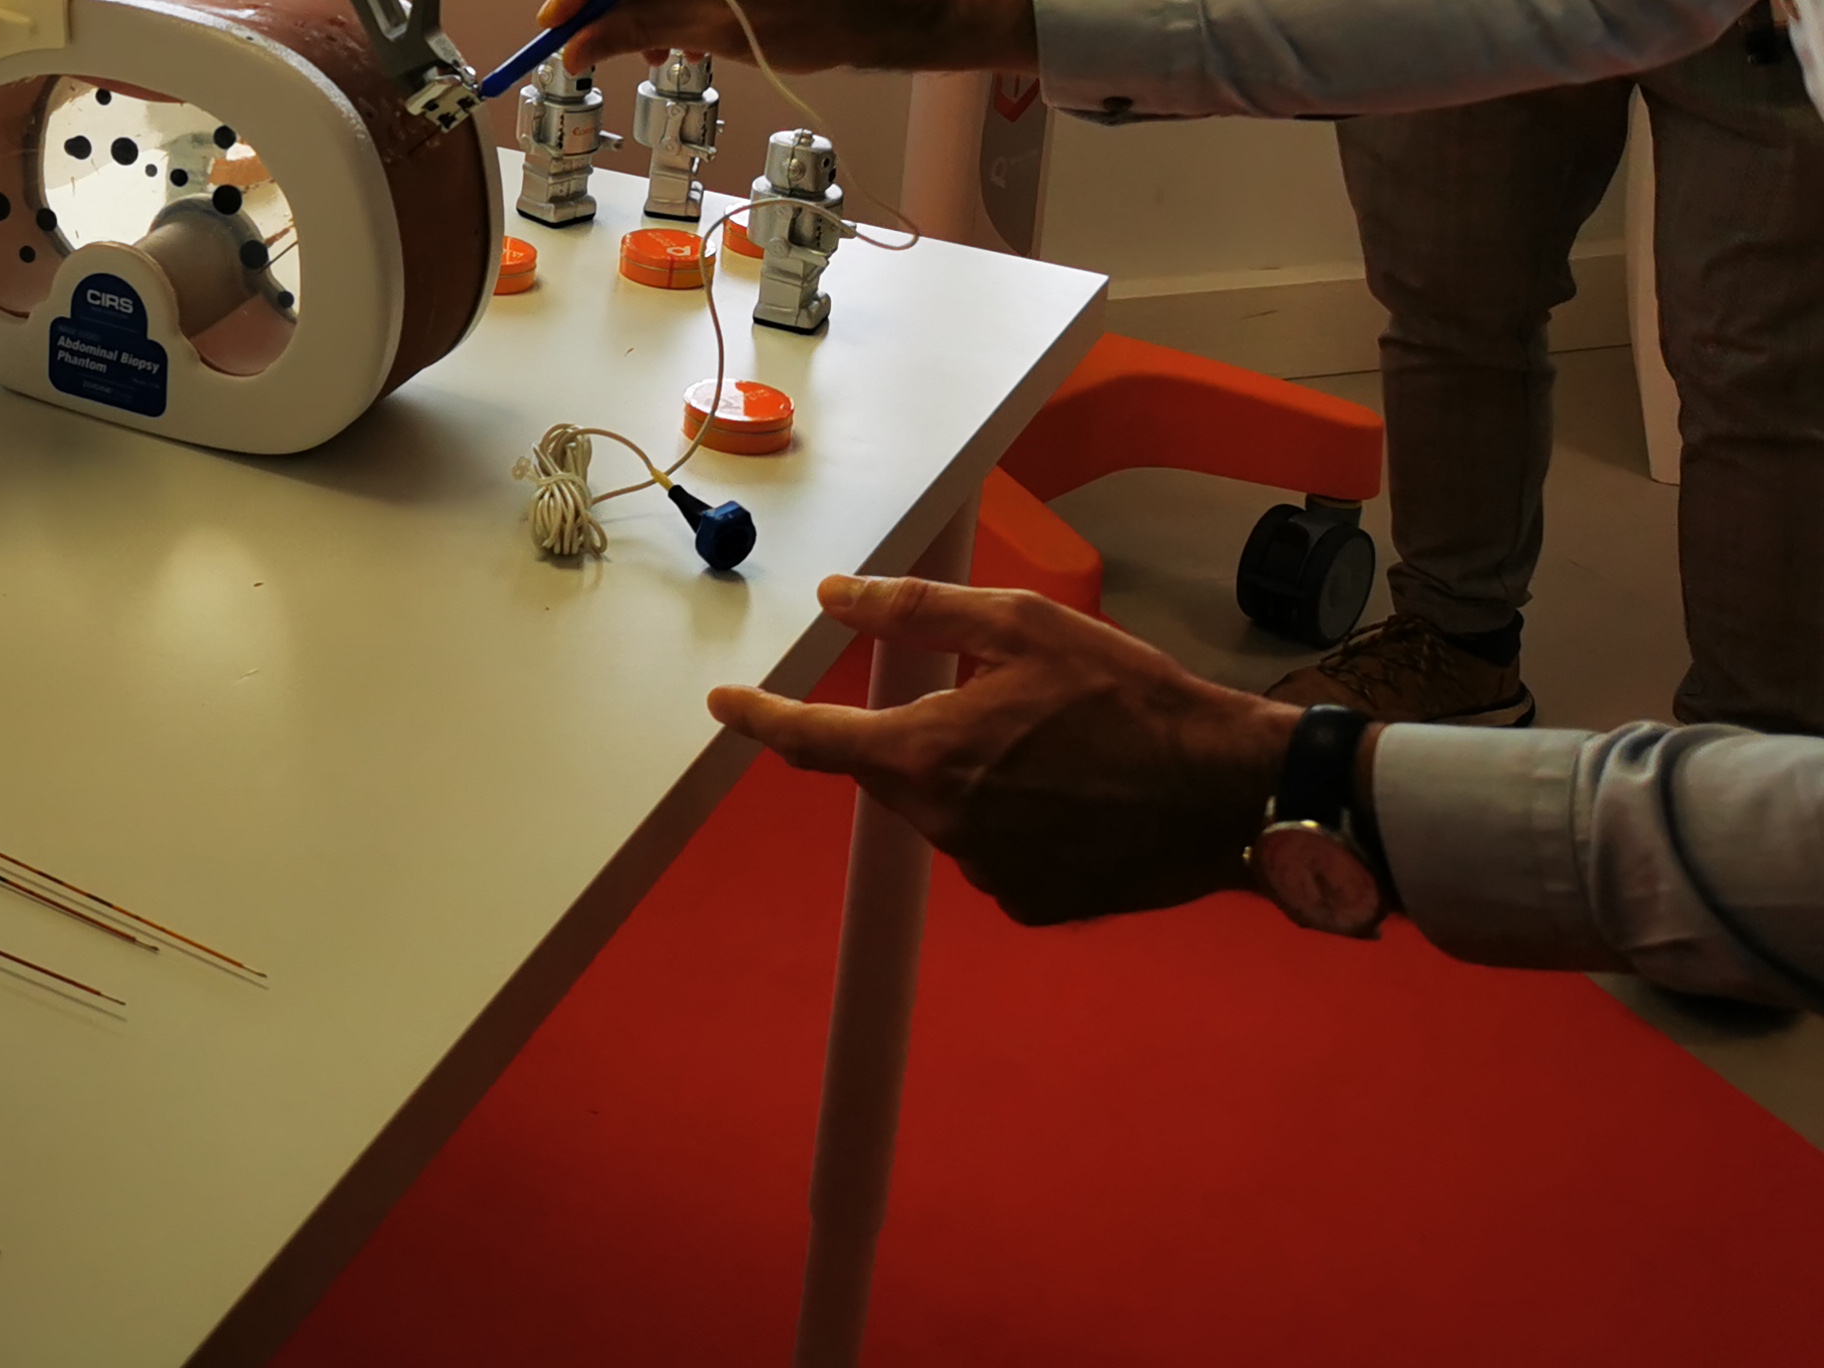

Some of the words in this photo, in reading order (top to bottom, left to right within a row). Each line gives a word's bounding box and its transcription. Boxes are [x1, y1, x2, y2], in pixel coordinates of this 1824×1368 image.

[86, 289, 134, 314] CIRS
[57, 336, 119, 362] Abdominal
[120, 352, 160, 375] Biopsy
[57, 350, 108, 374] Phantom
